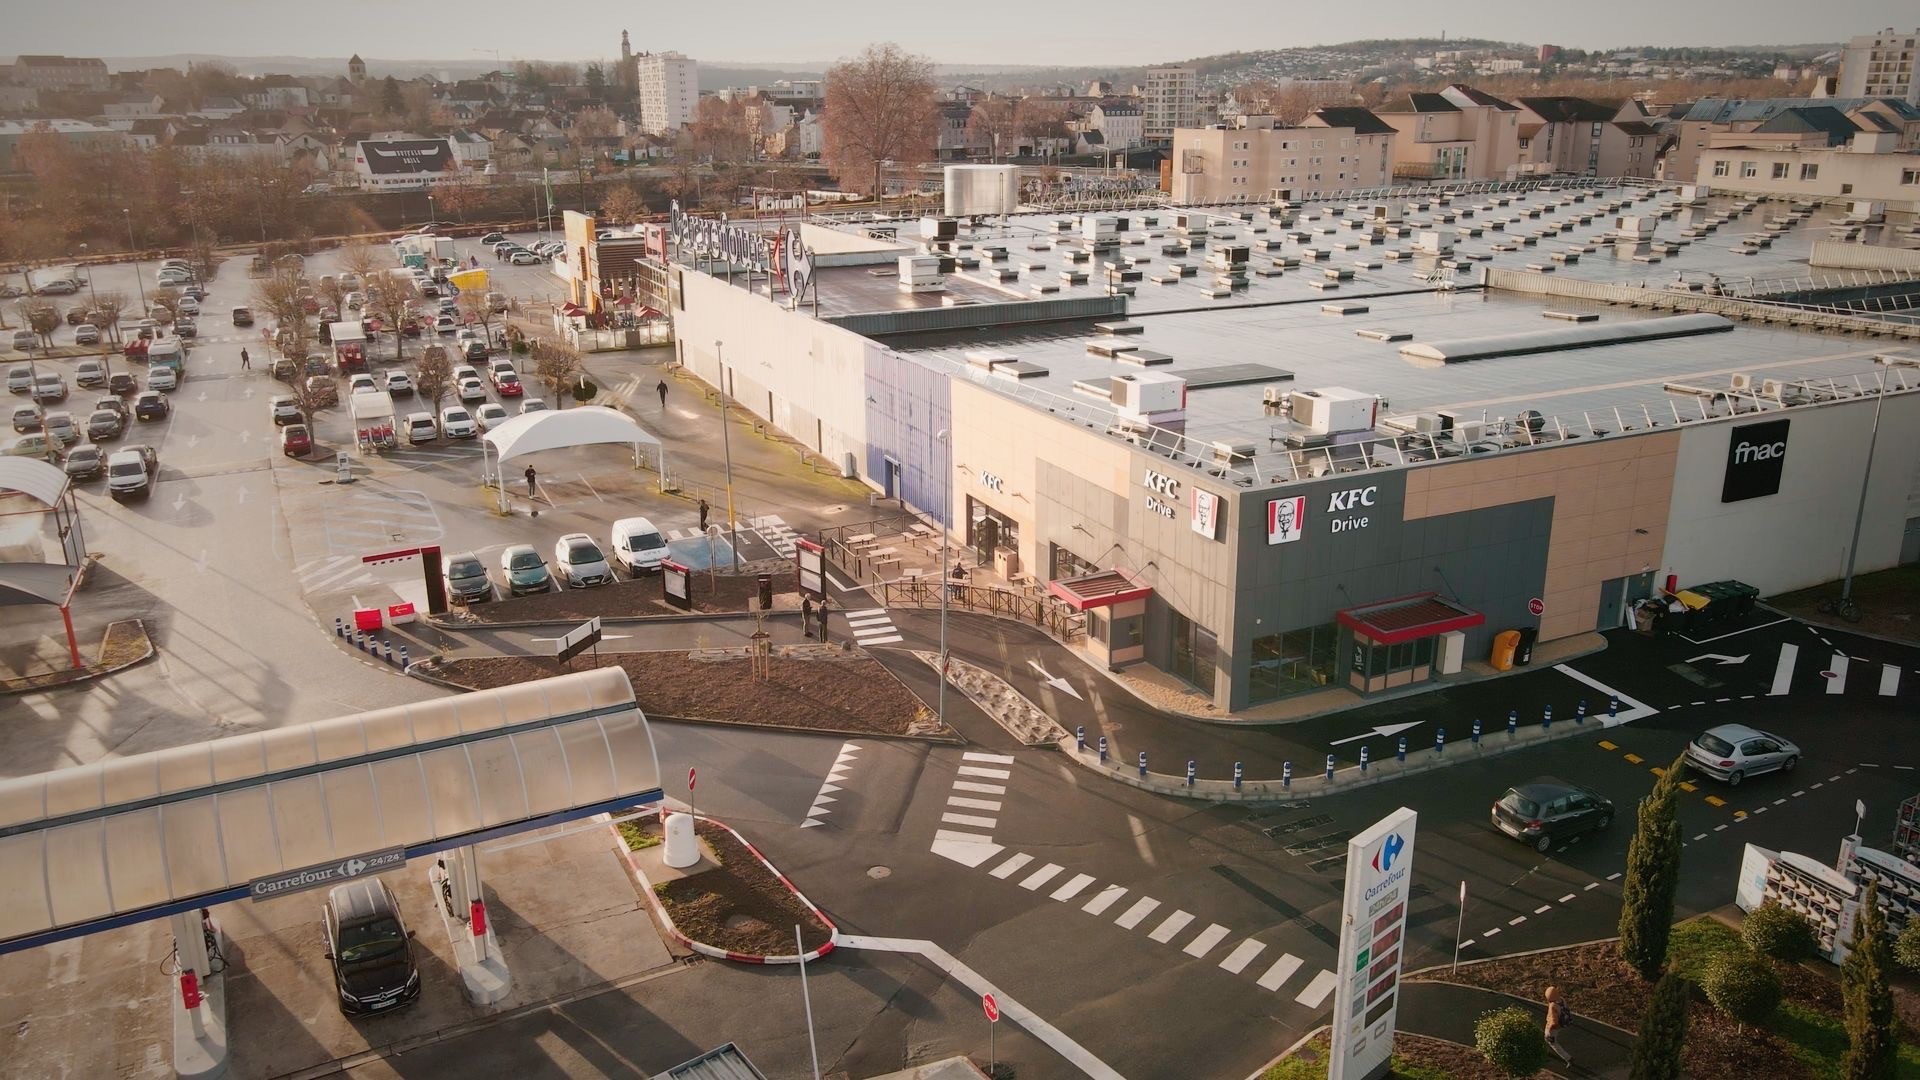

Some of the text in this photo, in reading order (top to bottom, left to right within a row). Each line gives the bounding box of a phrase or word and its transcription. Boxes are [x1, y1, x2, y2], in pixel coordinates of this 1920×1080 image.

[670, 199, 764, 273] Carrefour
[1735, 441, 1785, 464] fnac
[980, 470, 1003, 493] KFC
[1144, 469, 1179, 499] KFC
[1146, 496, 1173, 518] Drive
[1327, 486, 1377, 512] KFC
[1331, 516, 1369, 533] Drive
[1530, 602, 1543, 611] STOP
[255, 853, 400, 894] Carrefour 24/24
[1365, 867, 1406, 901] Carrefour
